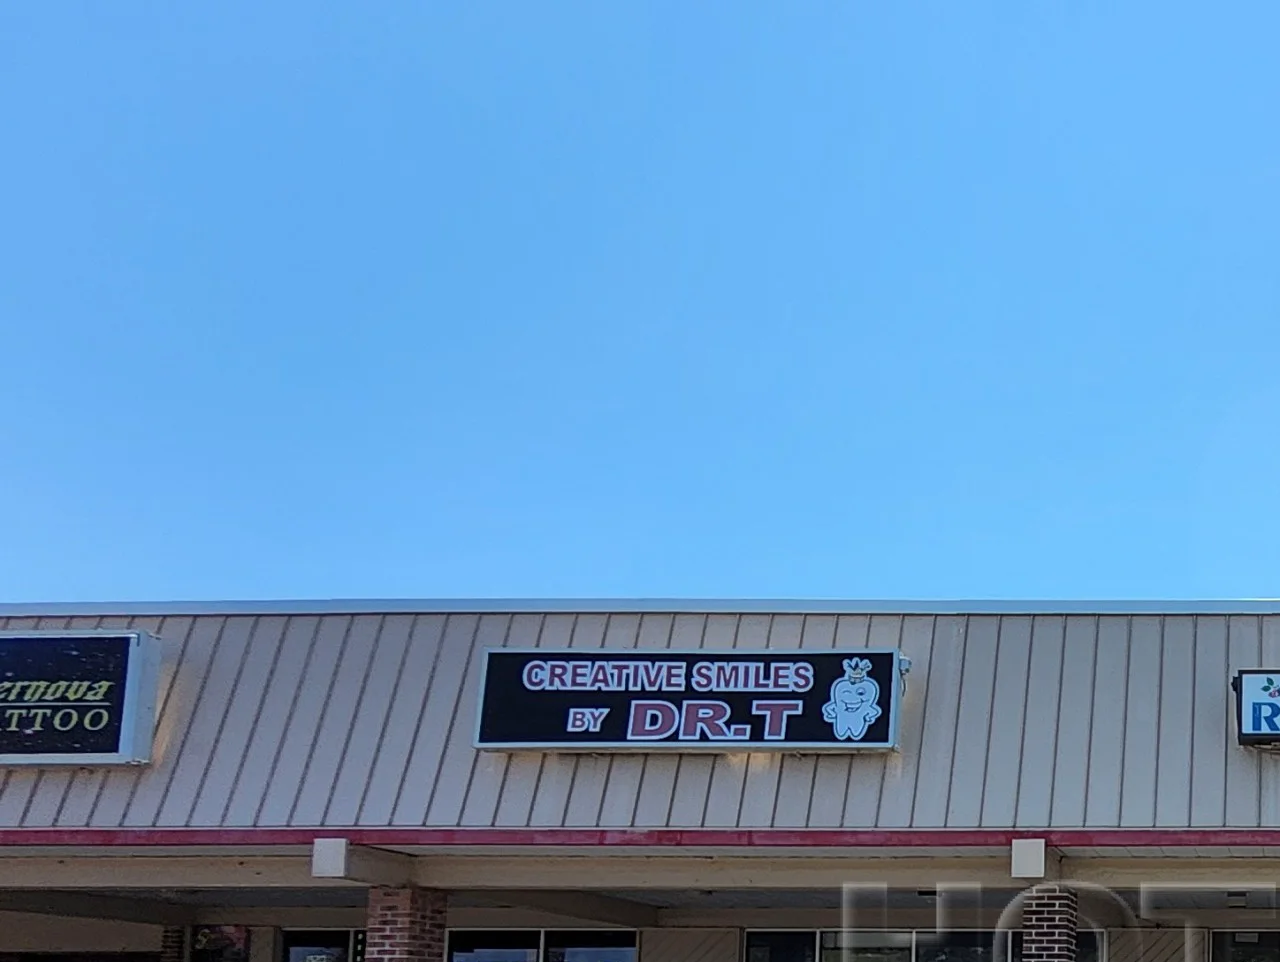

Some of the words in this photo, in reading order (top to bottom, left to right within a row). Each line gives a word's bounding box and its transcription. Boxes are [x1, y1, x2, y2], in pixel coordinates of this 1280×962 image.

[522, 660, 687, 691] CREATIVE
[691, 661, 814, 692] SMILES
[0, 708, 110, 731] TTOO
[566, 706, 610, 732] BY
[626, 700, 803, 740] DR.T
